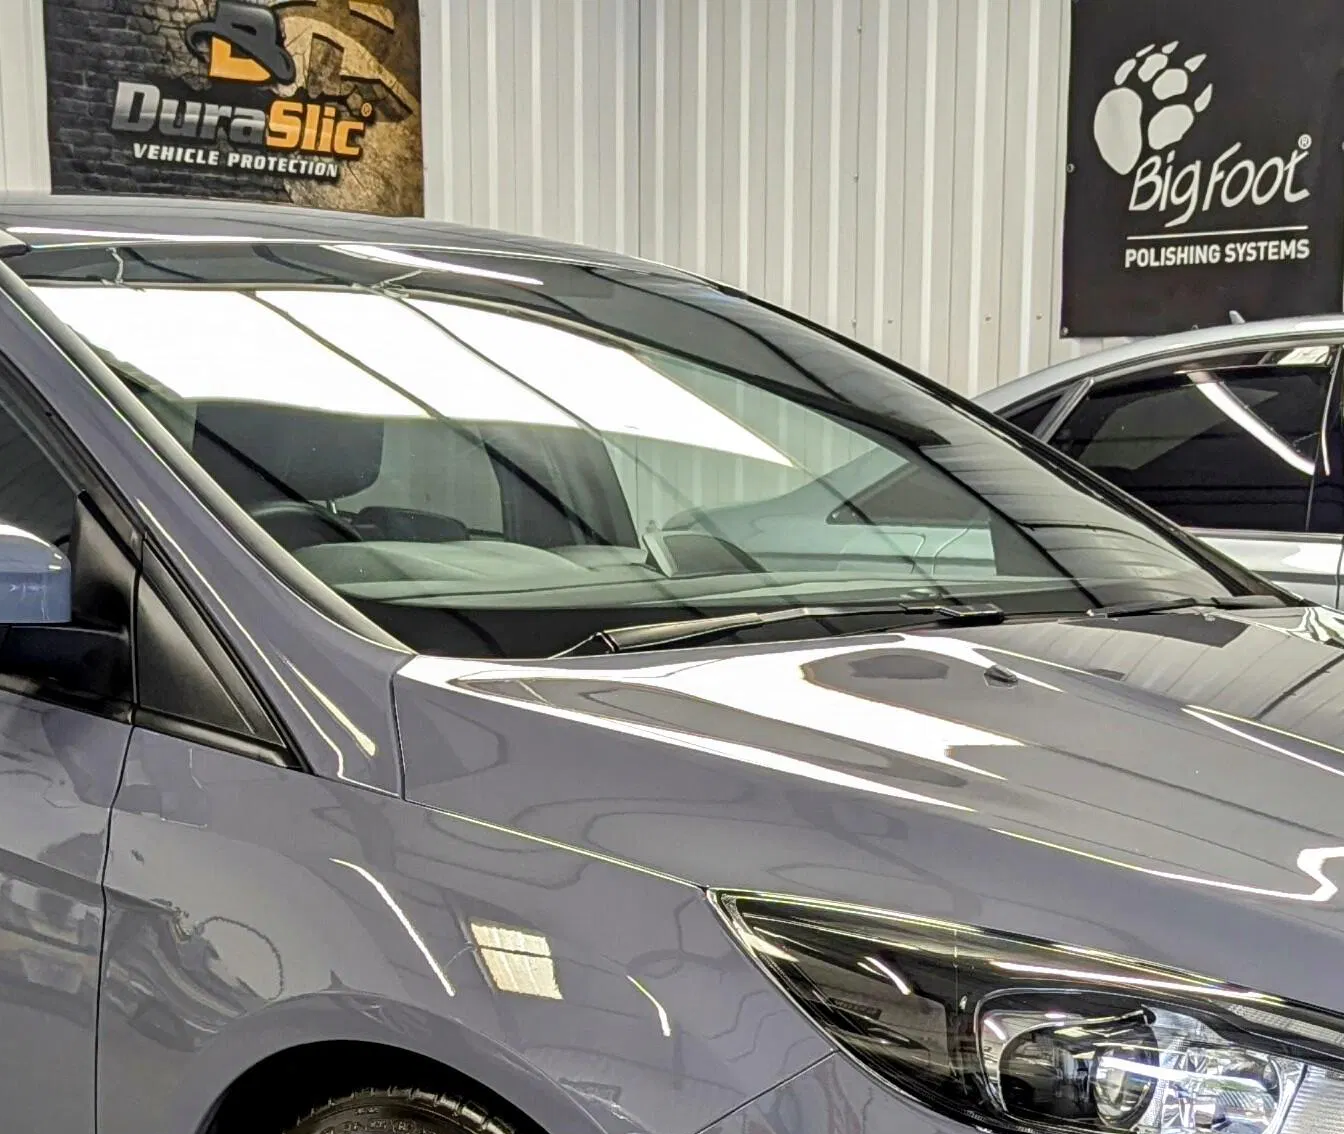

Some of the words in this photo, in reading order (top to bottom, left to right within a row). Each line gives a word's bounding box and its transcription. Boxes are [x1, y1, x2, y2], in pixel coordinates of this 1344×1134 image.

[133, 142, 219, 166] VEHICLE
[227, 152, 340, 178] PROTECTION
[1125, 244, 1221, 268] POLISHING
[1224, 238, 1311, 263] SYSTEMS
